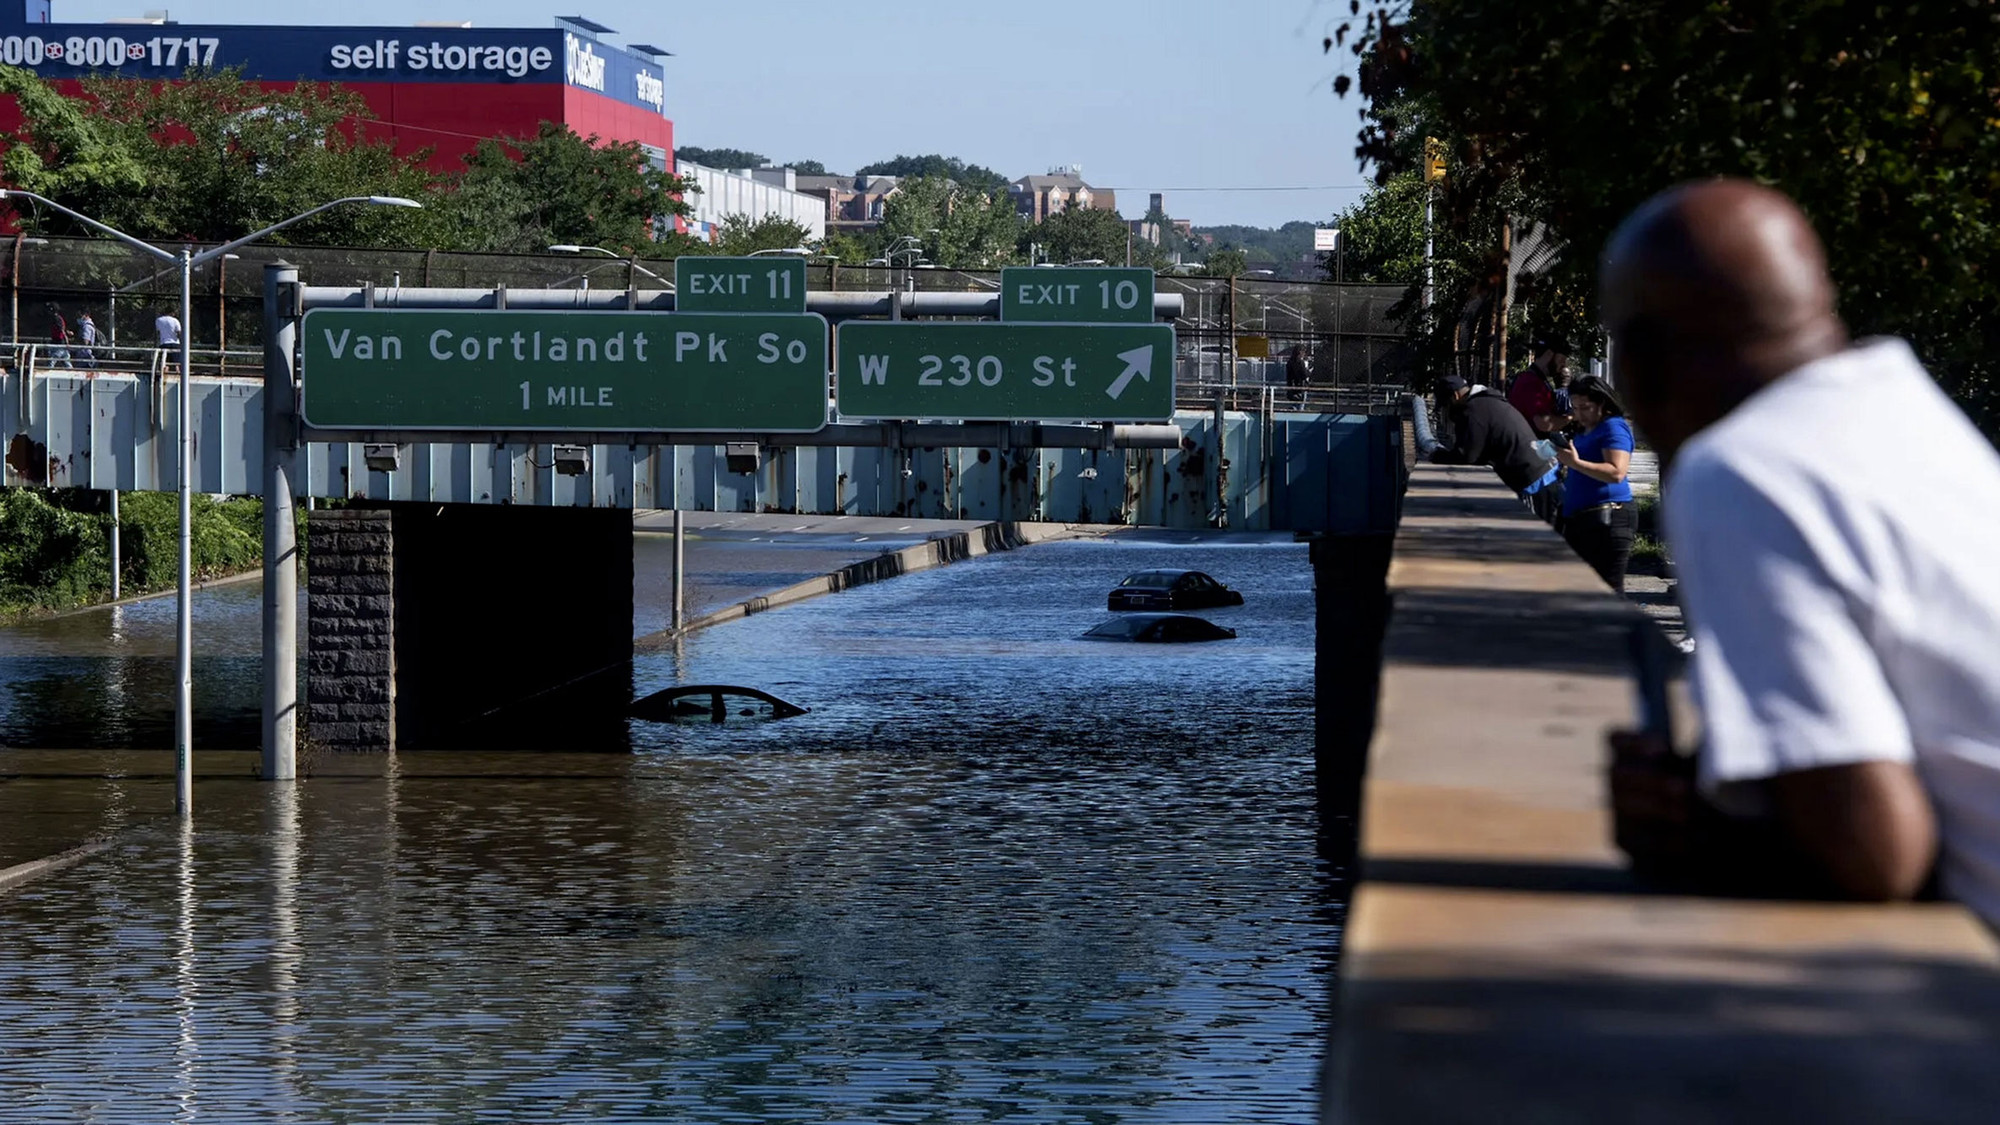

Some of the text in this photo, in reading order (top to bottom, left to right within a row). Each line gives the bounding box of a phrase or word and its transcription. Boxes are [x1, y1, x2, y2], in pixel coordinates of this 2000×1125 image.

[0, 36, 44, 65] 00
[331, 40, 552, 77] self storage
[690, 270, 796, 299] EXIT 11
[1019, 280, 1139, 309] EXIT 10
[324, 328, 807, 363] Van Cortlandt Pk So
[859, 355, 1076, 388] W 230 St
[520, 380, 613, 410] 1 MILE
